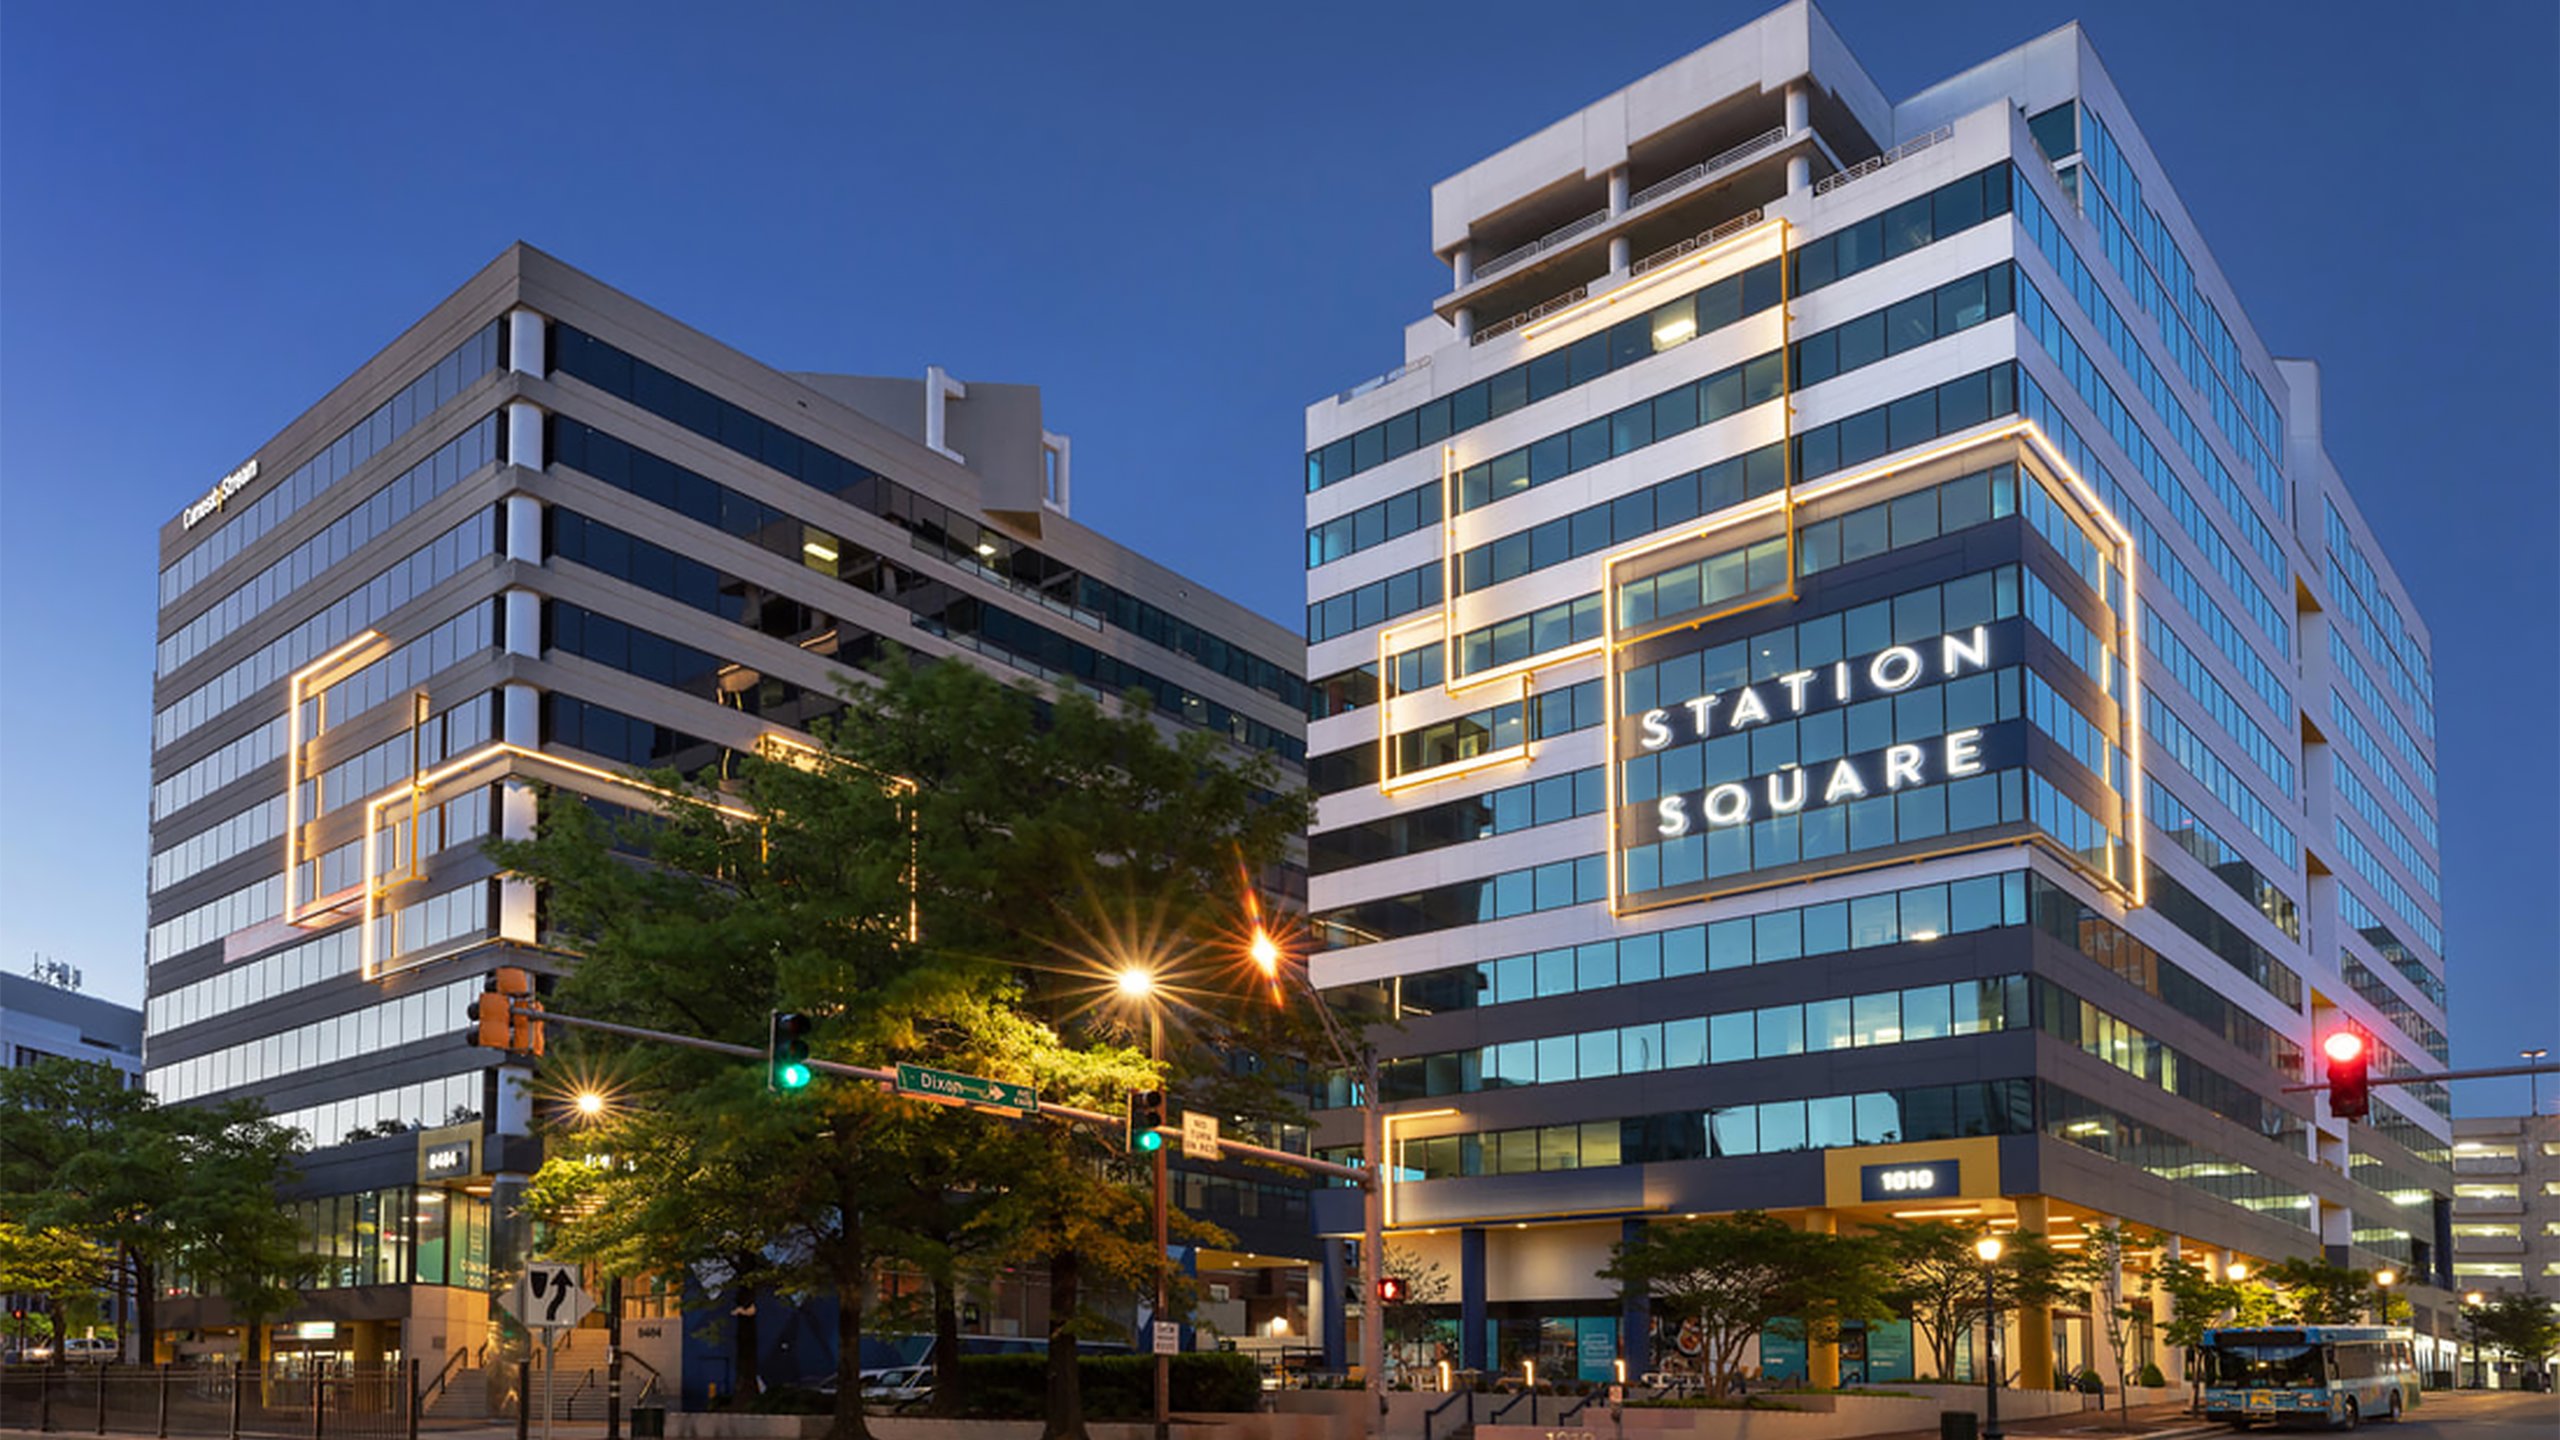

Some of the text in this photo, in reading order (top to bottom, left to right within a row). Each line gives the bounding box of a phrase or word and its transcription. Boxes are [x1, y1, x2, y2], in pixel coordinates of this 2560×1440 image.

[1641, 625, 1989, 750] STATION
[1657, 728, 1985, 836] SQUARE
[921, 1072, 963, 1095] Dixon
[1881, 1168, 1934, 1190] 1010
